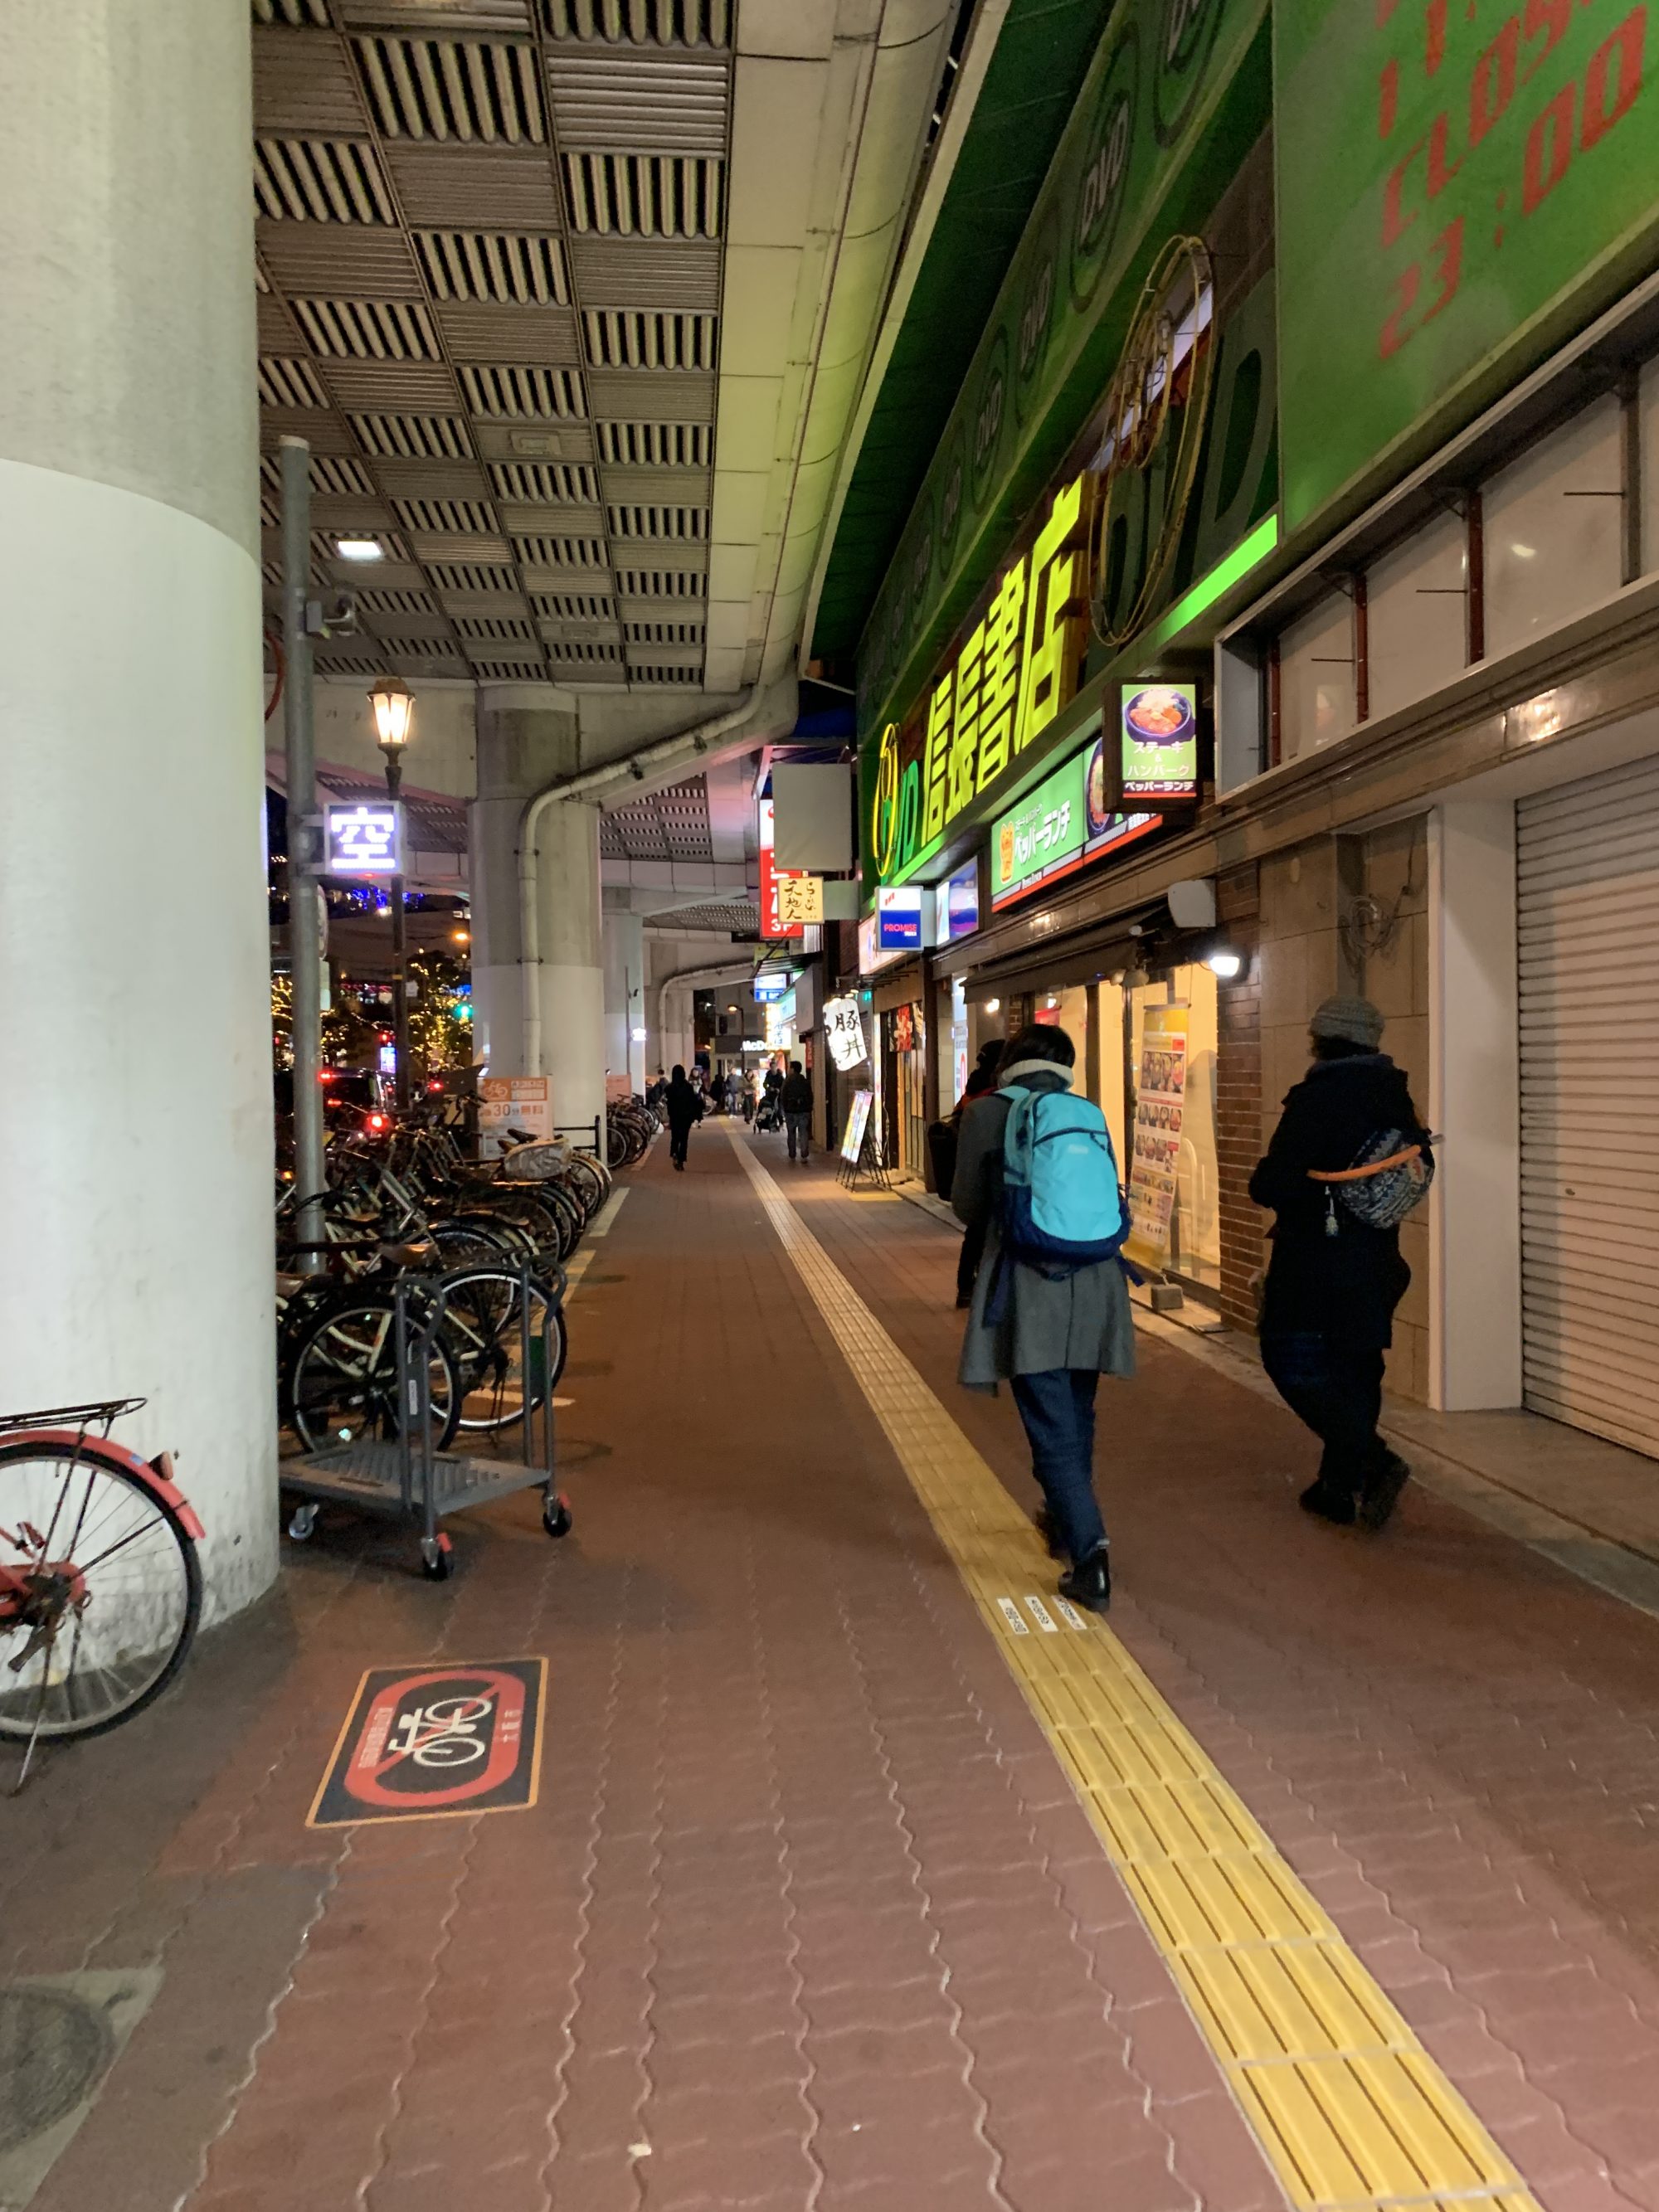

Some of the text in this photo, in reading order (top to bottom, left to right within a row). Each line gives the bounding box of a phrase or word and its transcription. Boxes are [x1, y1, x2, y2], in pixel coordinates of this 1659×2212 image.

[921, 471, 1082, 848] 信長書店
[1134, 741, 1184, 754] ステーキ
[1125, 781, 1194, 792] ペッパーランチ
[330, 806, 396, 869] 空
[1014, 799, 1071, 865] ペッパーランチ
[784, 880, 802, 920] 天地人
[883, 923, 917, 931] PROMISE
[834, 1009, 864, 1058] 豚丼
